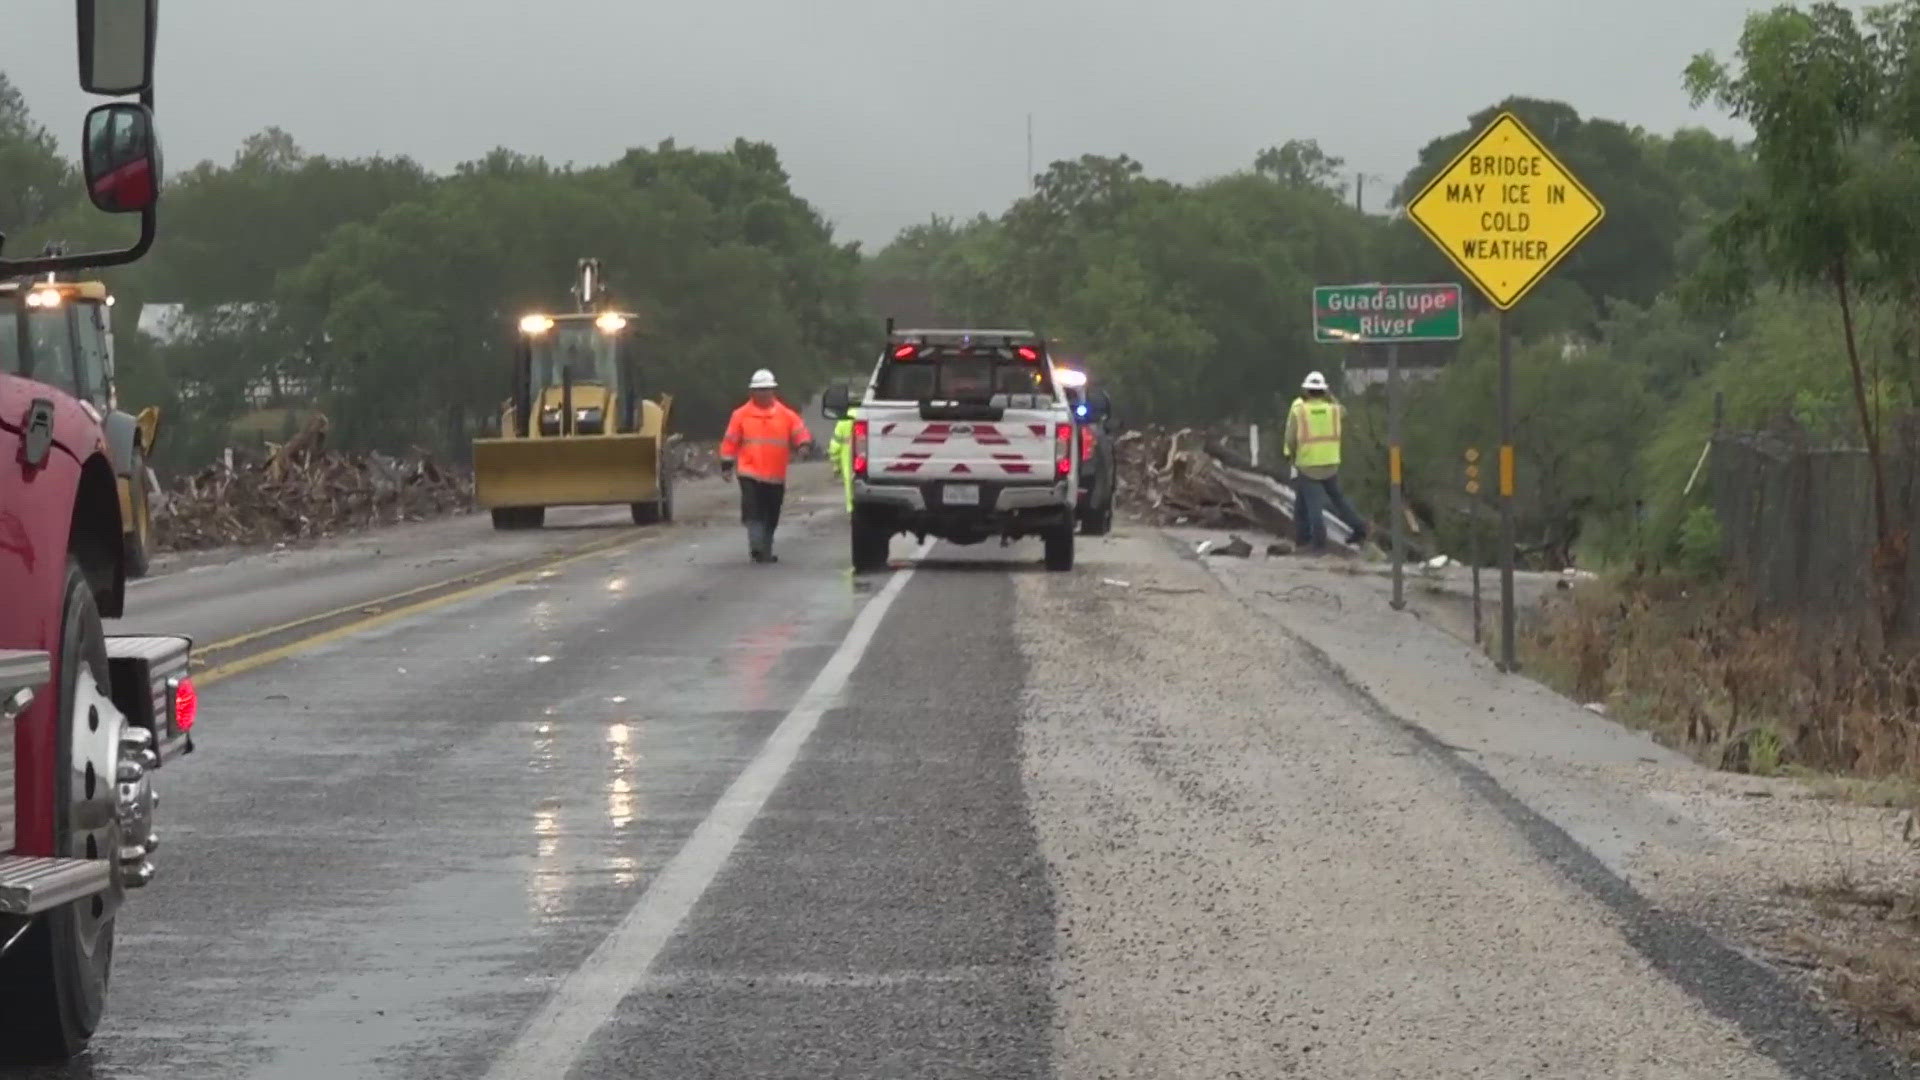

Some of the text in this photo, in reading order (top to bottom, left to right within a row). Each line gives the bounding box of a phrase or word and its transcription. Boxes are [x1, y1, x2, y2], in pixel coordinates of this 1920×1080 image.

[1469, 155, 1542, 177] BRIDGE
[1446, 183, 1565, 205] MAY ICE IN
[1481, 211, 1530, 232] COLD
[1462, 240, 1549, 260] WEATHER
[1328, 290, 1447, 314] Guadalupe
[1359, 316, 1415, 336] River
